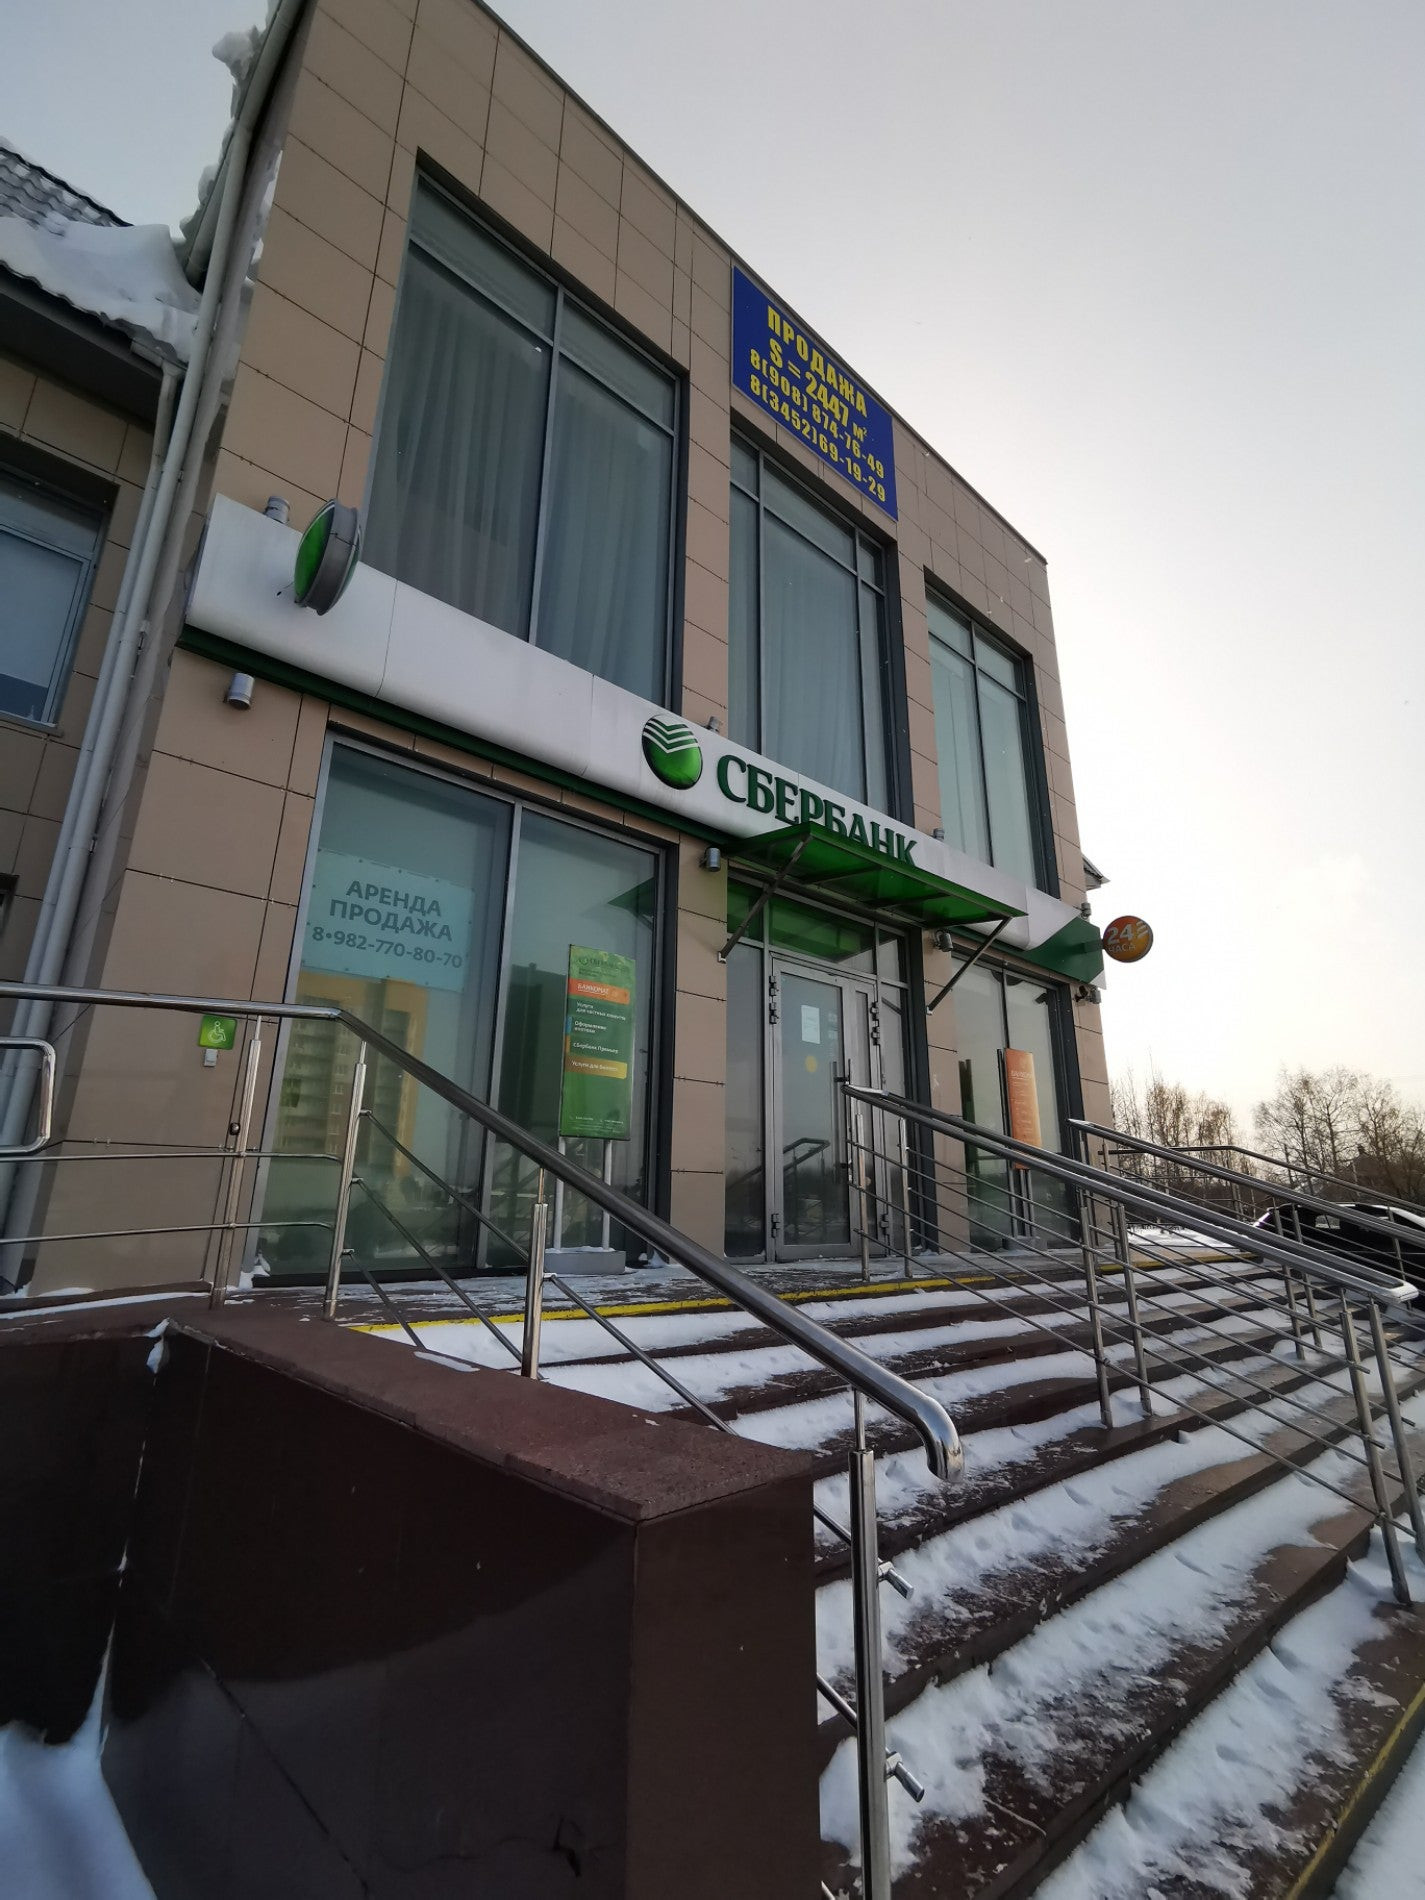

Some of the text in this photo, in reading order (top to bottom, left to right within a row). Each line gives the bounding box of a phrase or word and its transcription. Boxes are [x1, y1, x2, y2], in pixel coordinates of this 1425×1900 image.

[767, 305, 868, 418] ПРОДАЖА
[769, 338, 783, 369] S
[805, 371, 850, 428] 2447
[716, 754, 918, 867] СБЕРБАНК
[329, 899, 453, 942] ПРОДАЖА
[345, 880, 442, 917] АРЕНДА
[1107, 923, 1135, 945] 24
